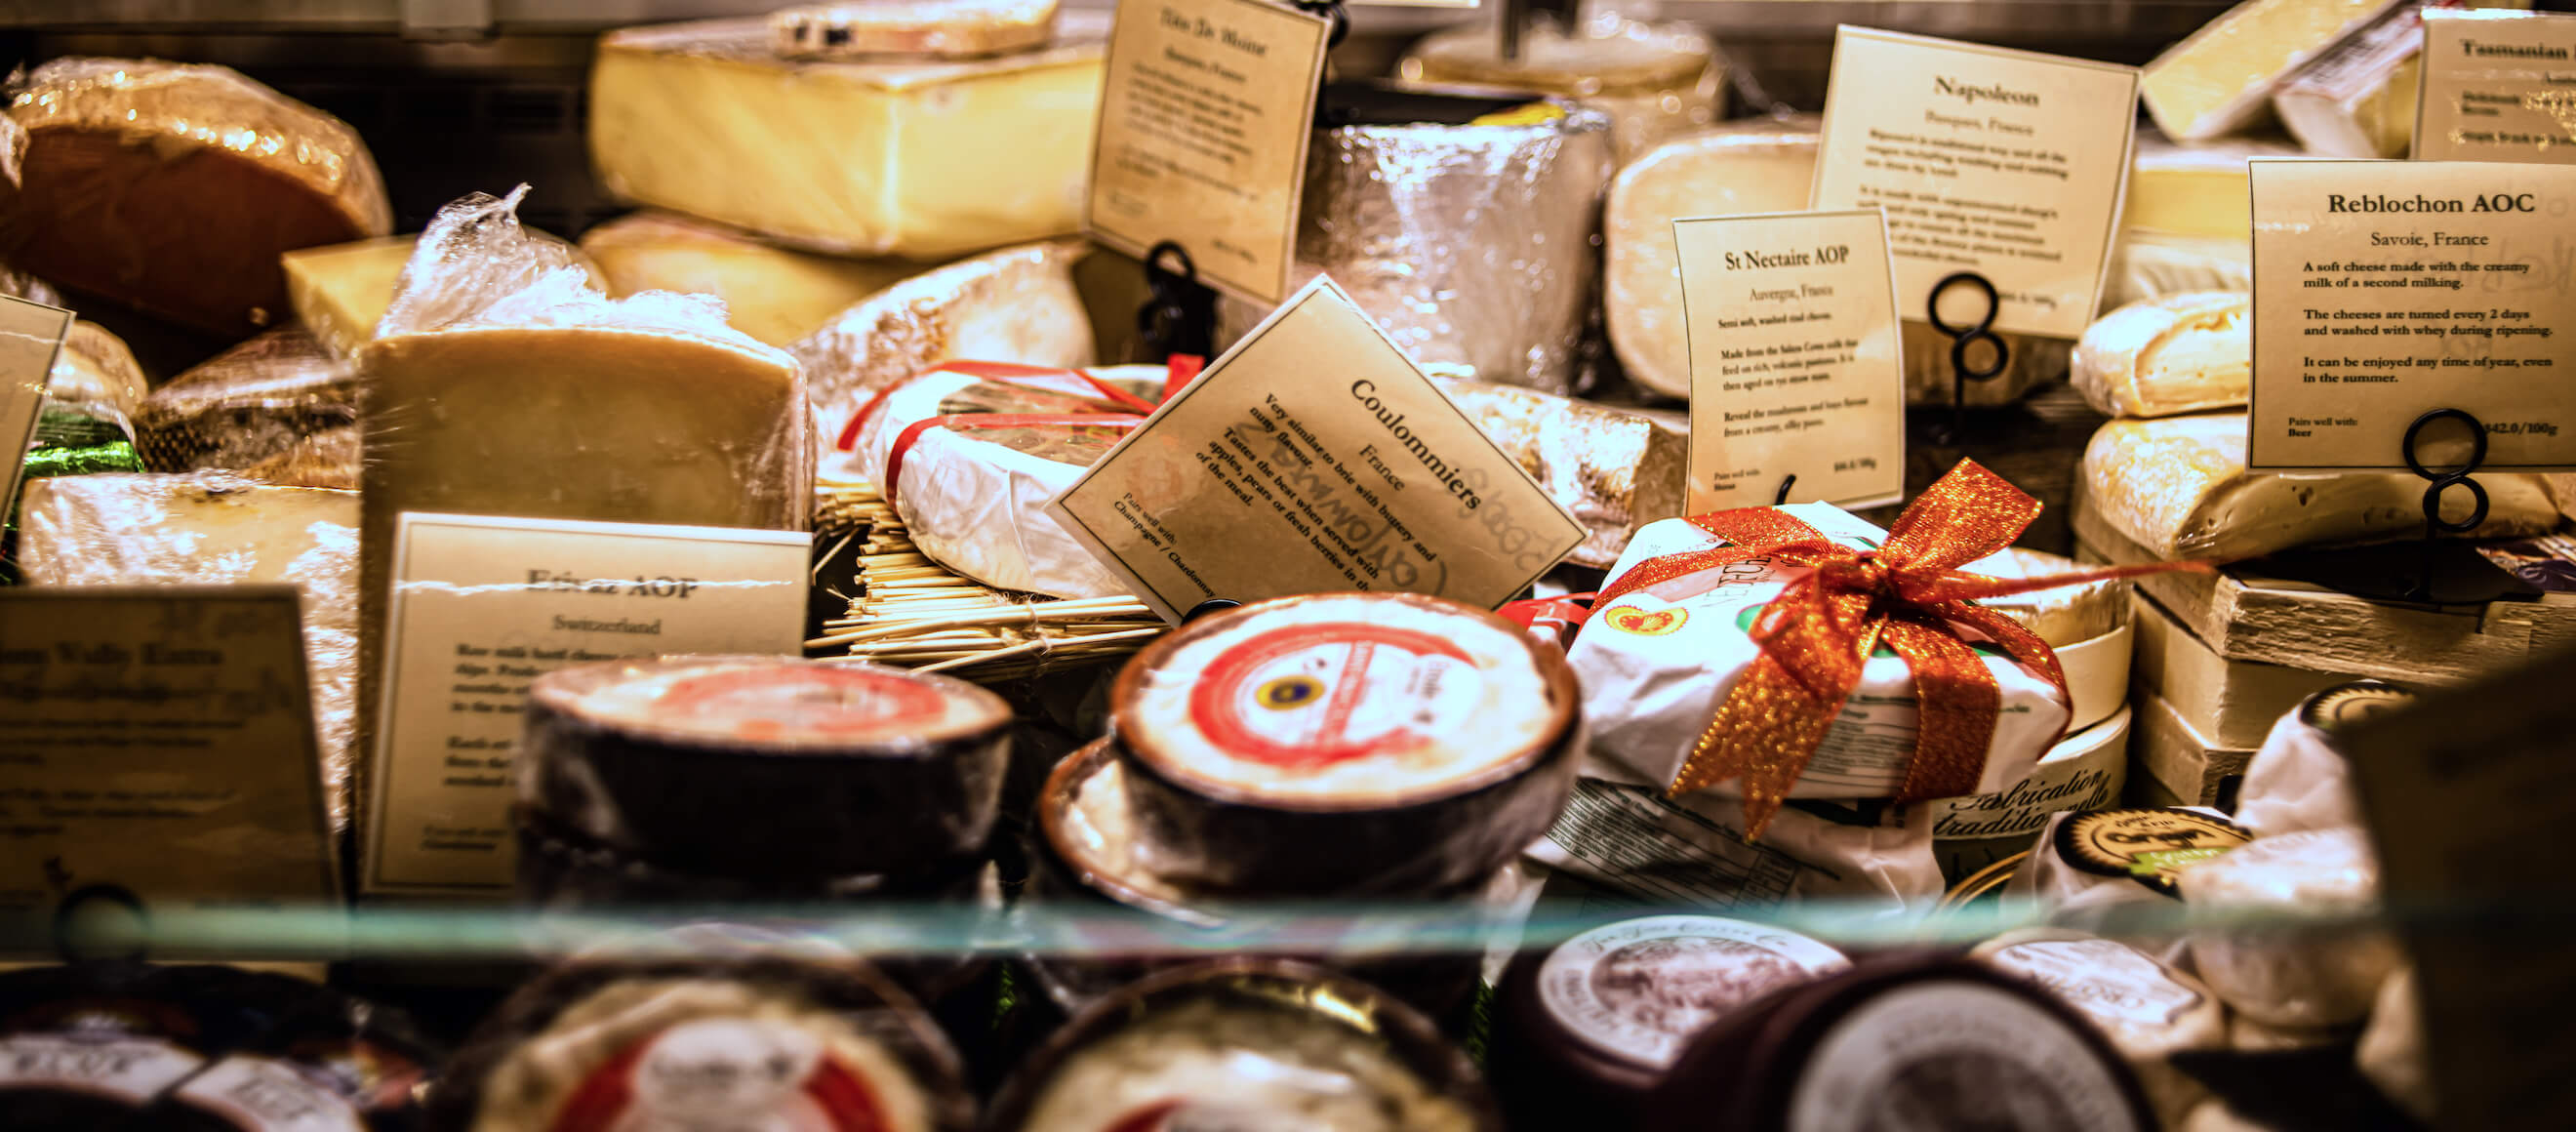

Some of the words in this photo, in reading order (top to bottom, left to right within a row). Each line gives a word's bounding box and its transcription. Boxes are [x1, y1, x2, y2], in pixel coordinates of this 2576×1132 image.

[1935, 75, 2039, 106] Napoleon
[2327, 194, 2464, 213] Reblochon
[2471, 193, 2535, 213] AOC
[2370, 231, 2429, 249] Savoie,
[2433, 231, 2489, 246] France
[1724, 252, 1741, 270] St
[1744, 249, 1810, 269] Nectaire
[1815, 245, 1849, 264] AOP
[2303, 262, 2314, 272] A
[2316, 261, 2340, 272] soft
[2343, 261, 2387, 272] cheese
[2390, 261, 2426, 272] made
[2428, 261, 2458, 272] with
[2460, 261, 2480, 272] the
[2482, 263, 2530, 274] creamy
[2303, 277, 2333, 288] milk
[2335, 276, 2351, 288] of
[2362, 276, 2408, 288] second
[2411, 276, 2464, 291] milking.
[2303, 308, 2330, 320] The
[2332, 308, 2382, 320] cheeses
[2385, 311, 2405, 320] are
[2408, 308, 2450, 320] turned
[2452, 311, 2486, 322] every
[2489, 308, 2498, 319] 2
[2500, 308, 2530, 322] days
[2304, 325, 2328, 336] and
[2331, 324, 2379, 336] washed
[2382, 324, 2410, 336] with
[2412, 324, 2447, 339] whey
[2449, 324, 2493, 339] during
[2495, 324, 2554, 339] ripening.
[2304, 356, 2313, 367] It
[2343, 356, 2359, 367] be
[2362, 355, 2413, 370] enjoyed
[2415, 358, 2438, 370] any
[2441, 356, 2471, 367] time
[2473, 355, 2489, 367] of
[2488, 358, 2520, 370] year,
[2522, 358, 2554, 367] even
[2303, 373, 2316, 384] in
[2319, 372, 2340, 384] the
[2342, 375, 2398, 384] summer.
[2288, 417, 2312, 426] Pairs
[2313, 417, 2333, 426] well
[2334, 417, 2358, 426] with:
[2288, 427, 2312, 437] Beer
[1249, 407, 1277, 433] nutty
[1272, 431, 1313, 469] flavour.
[1351, 379, 1481, 510] Coulommiers
[1195, 452, 1213, 464] of
[1207, 463, 1226, 480] the
[1224, 479, 1254, 506] meal.
[1266, 393, 1289, 421] Very
[1287, 419, 1325, 455] similar
[1321, 452, 1335, 465] to
[1334, 462, 1355, 485] brie
[1355, 484, 1379, 507] with
[1378, 504, 1415, 542] buttery
[1413, 542, 1437, 562] and
[1358, 444, 1406, 494] France
[1224, 426, 1257, 462] Tastes
[1256, 461, 1274, 478] the
[1273, 475, 1297, 500] best
[1296, 499, 1323, 526] when
[1322, 525, 1361, 557] served
[1356, 555, 1380, 580] with
[1123, 492, 1144, 512] Pairs
[1142, 510, 1160, 528] well
[1157, 526, 1177, 545] with:
[1209, 441, 1243, 476] apples,
[1241, 473, 1273, 501] pears
[1272, 501, 1286, 512] or
[1284, 510, 1310, 538] fresh
[1309, 535, 1346, 570] berries
[1344, 567, 1356, 582] in
[1355, 580, 1369, 592] th
[1114, 501, 1162, 547] Champagne
[1168, 551, 1215, 598] Chardonnay
[625, 573, 700, 601] AOP
[552, 614, 662, 636] Switzerland
[1948, 768, 2105, 812] Fabrication
